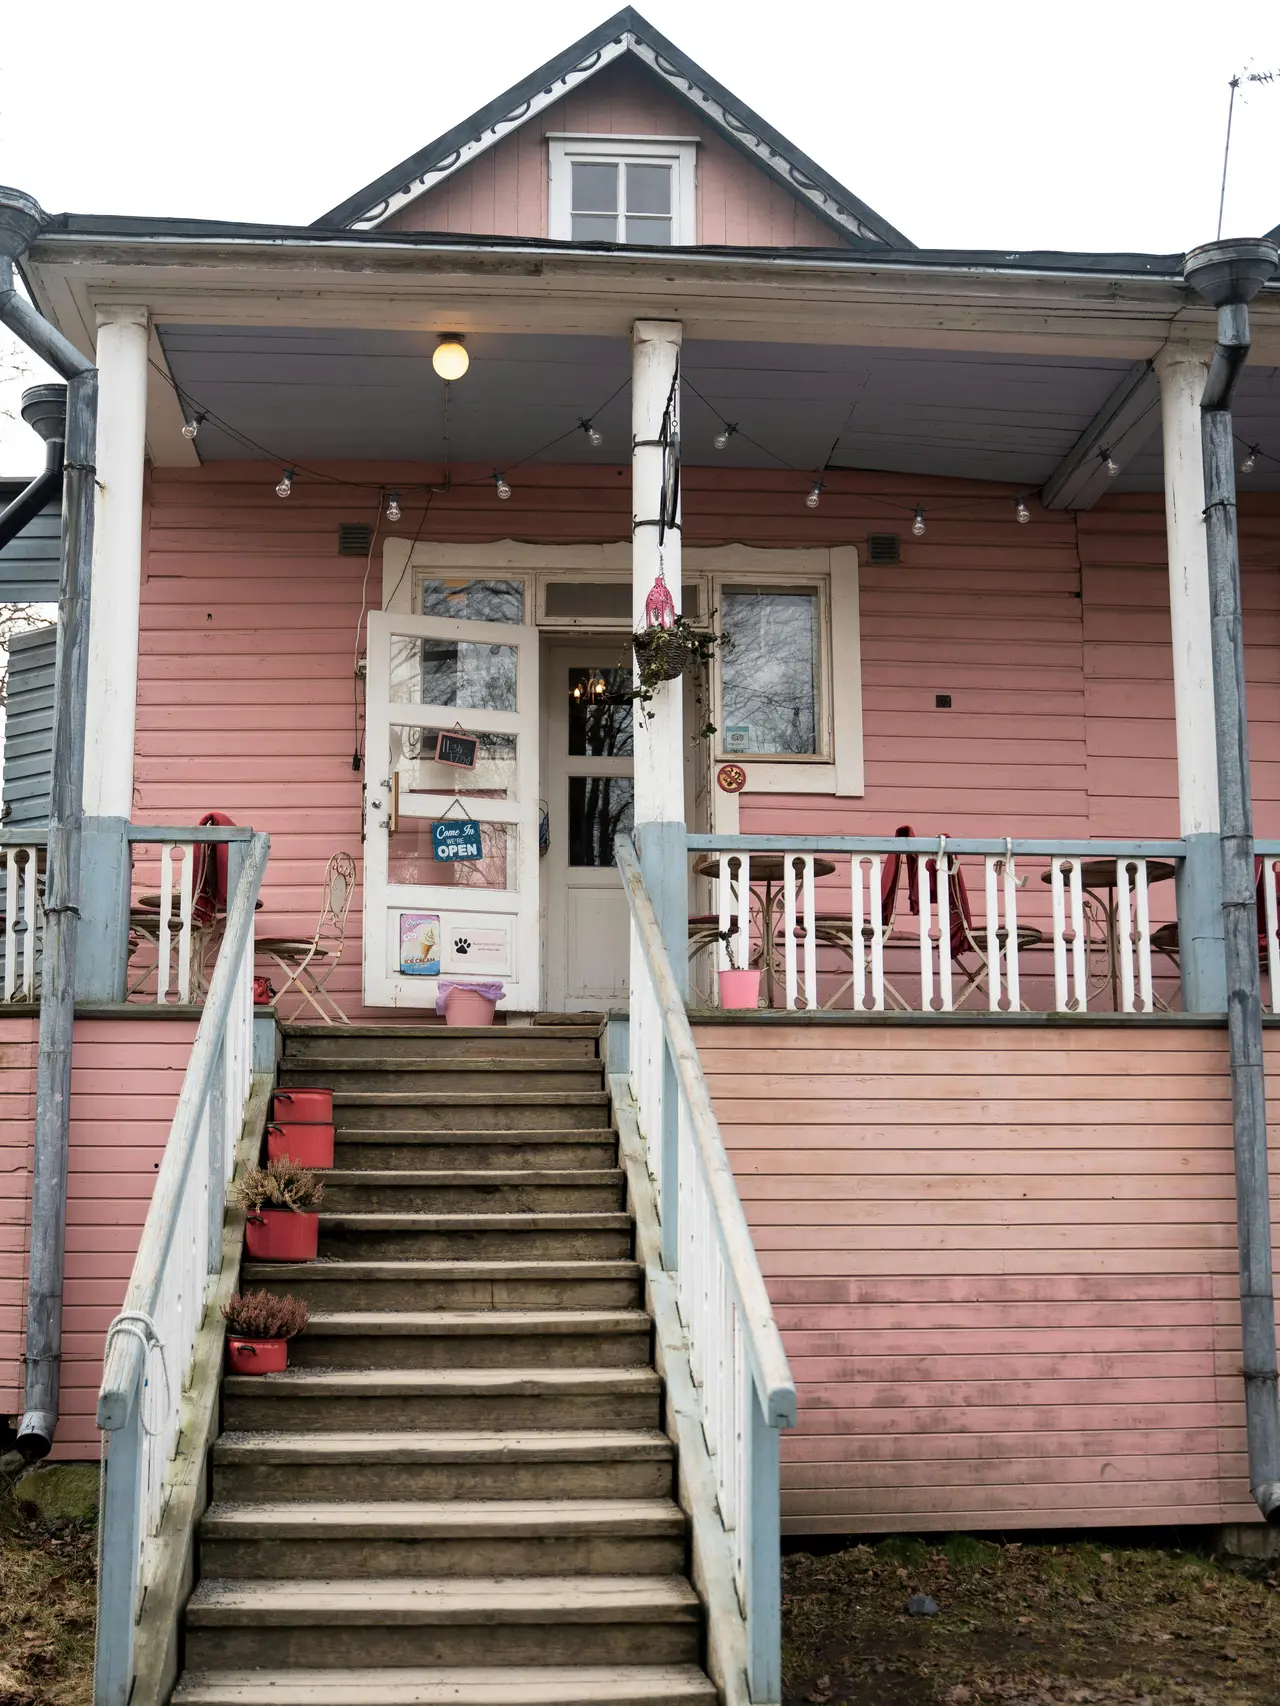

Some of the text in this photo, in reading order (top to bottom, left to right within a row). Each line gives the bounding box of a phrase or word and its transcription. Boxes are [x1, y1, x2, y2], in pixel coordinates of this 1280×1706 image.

[436, 824, 475, 839] Come In
[446, 837, 464, 845] WE'RE
[437, 843, 477, 857] OPEN
